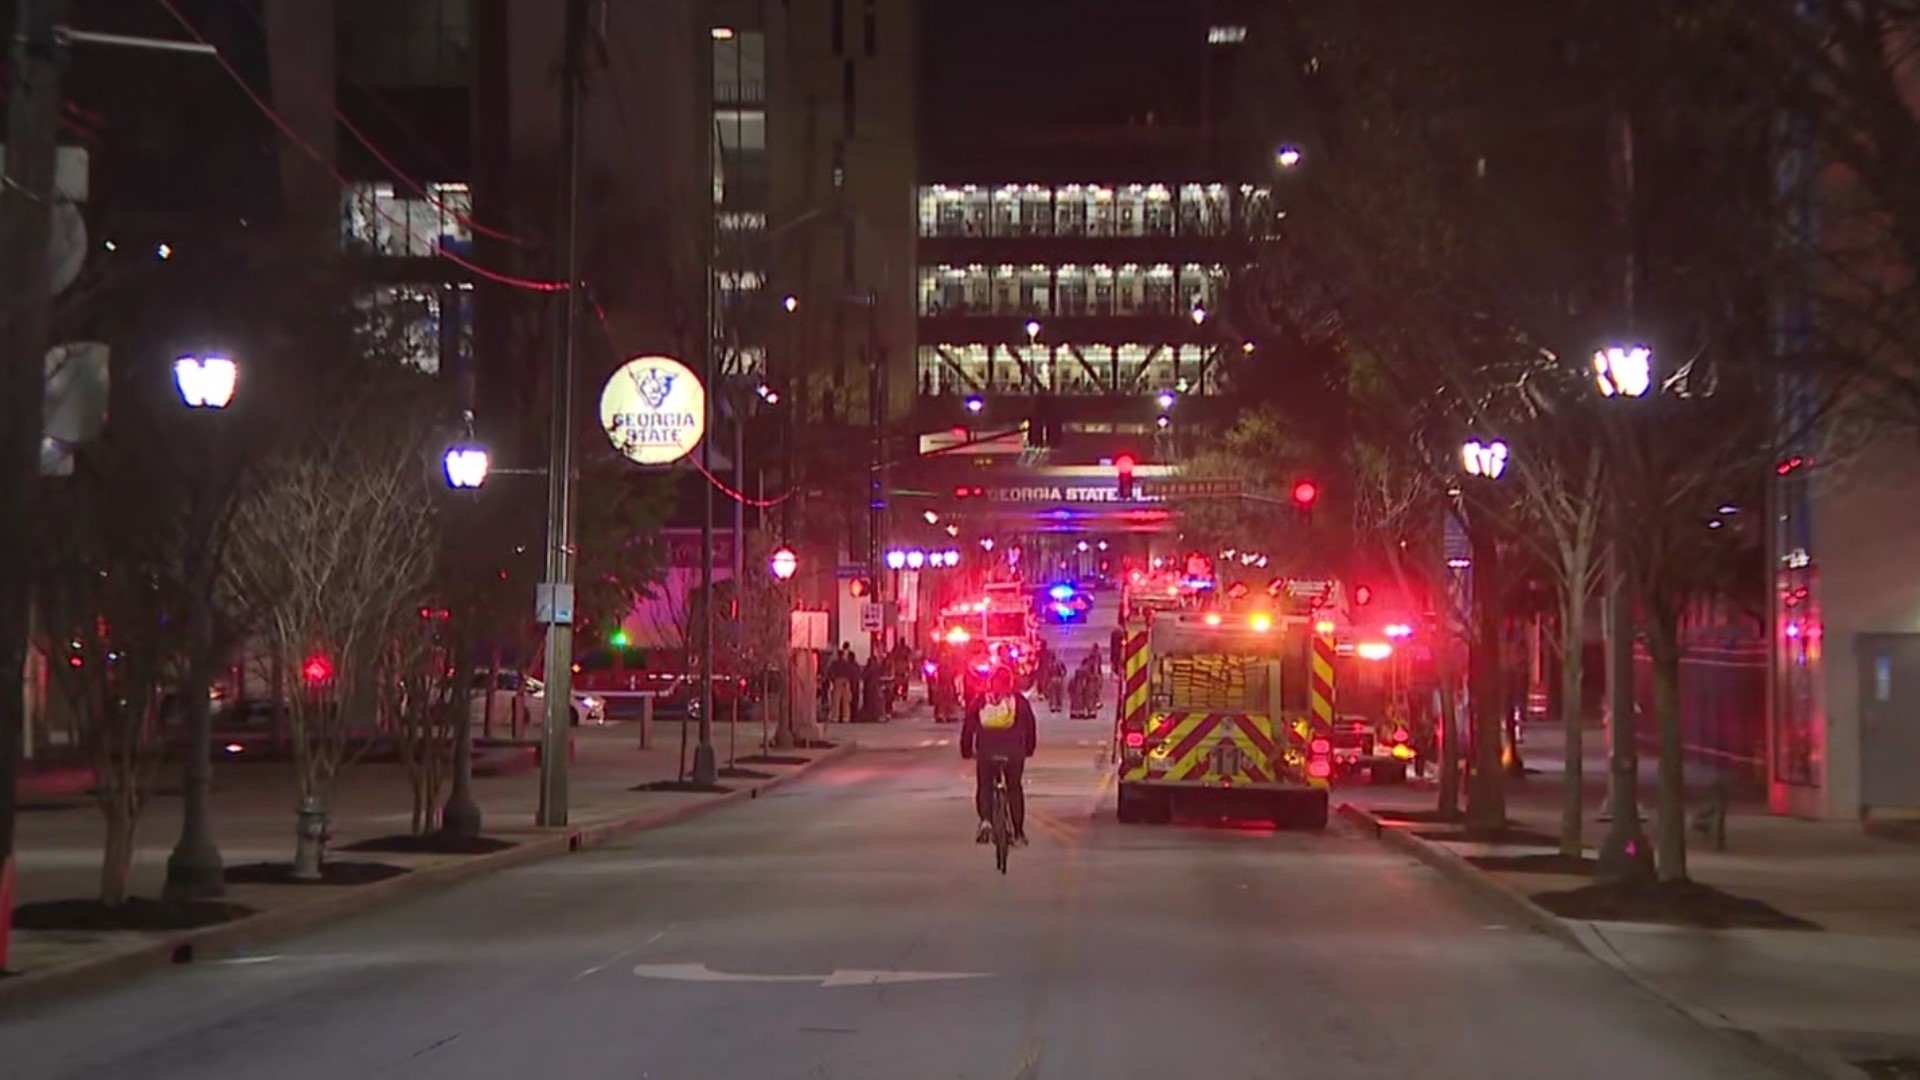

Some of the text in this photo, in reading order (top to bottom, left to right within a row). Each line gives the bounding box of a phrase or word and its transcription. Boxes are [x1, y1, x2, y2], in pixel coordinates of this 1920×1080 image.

[612, 413, 695, 427] GEORGIA
[626, 428, 682, 442] STATE
[987, 487, 1062, 501] GEORGIA
[1065, 487, 1118, 501] STATE
